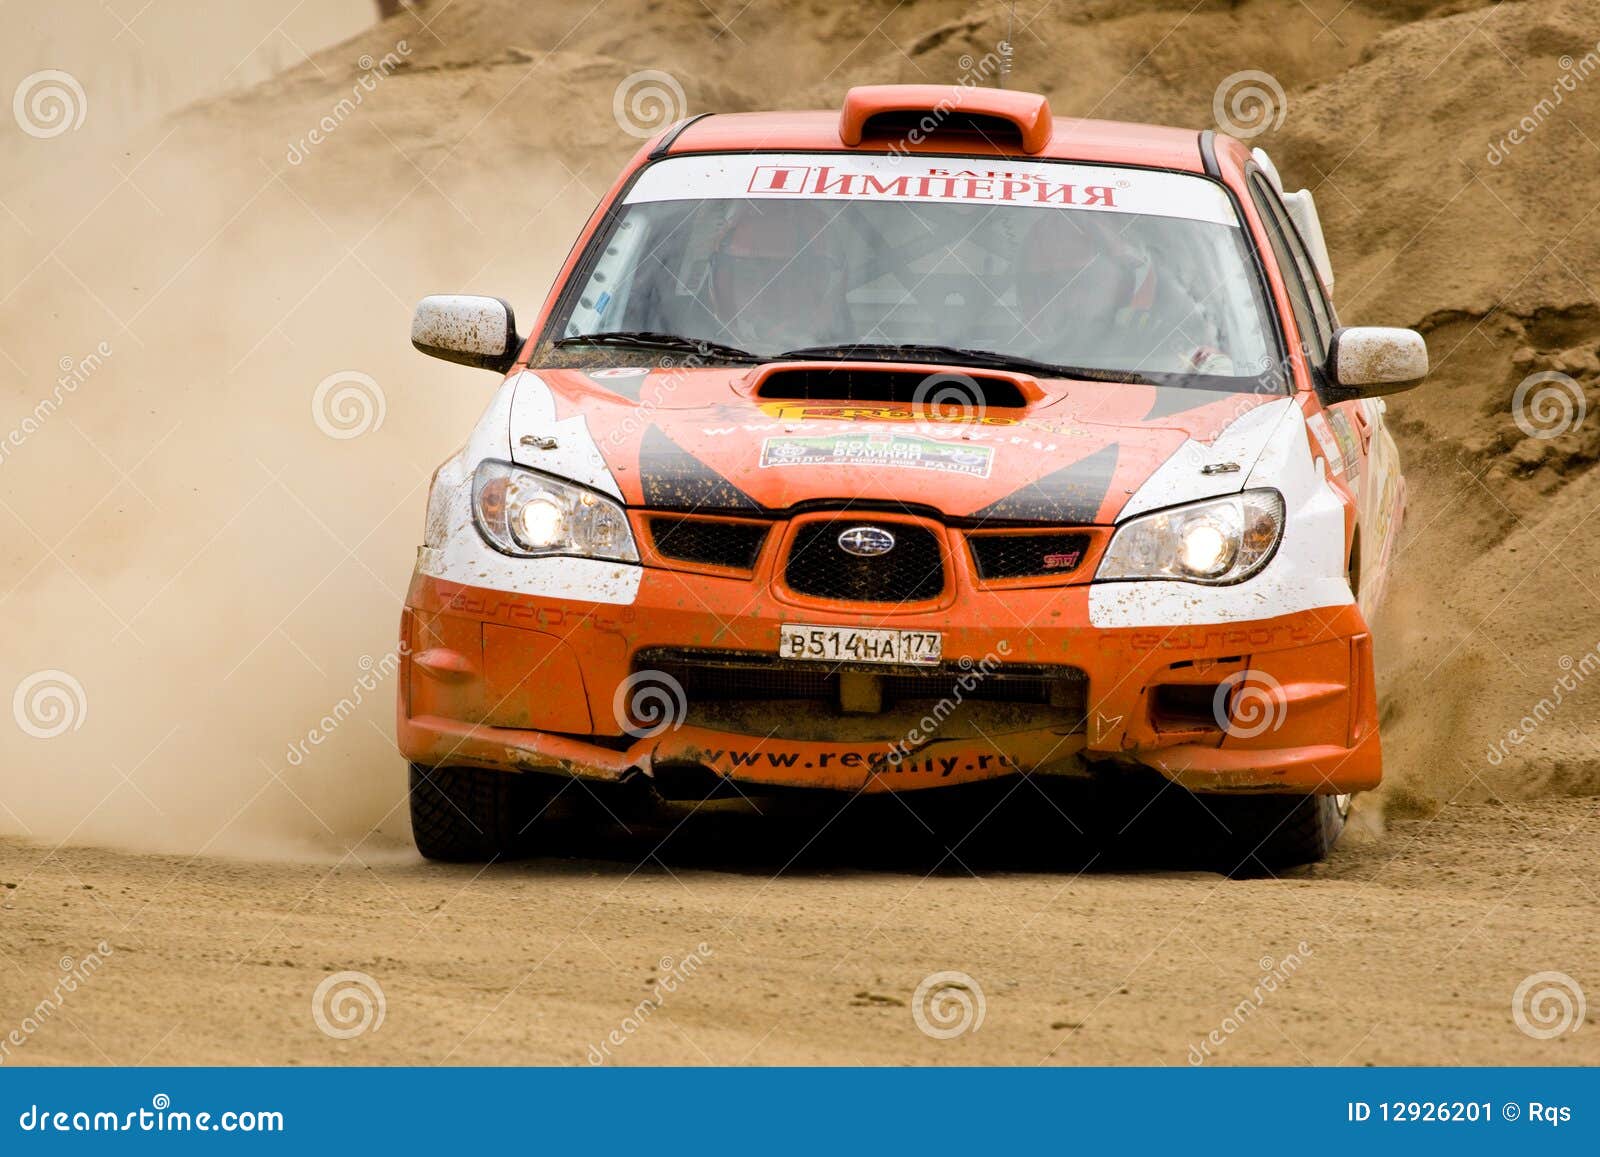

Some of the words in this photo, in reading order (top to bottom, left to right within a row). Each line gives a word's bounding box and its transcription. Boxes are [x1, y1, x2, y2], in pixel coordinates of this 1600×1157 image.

[929, 168, 1054, 182] БАНК
[809, 166, 1119, 208] ИМПЕРИЯ
[902, 633, 938, 654] 177
